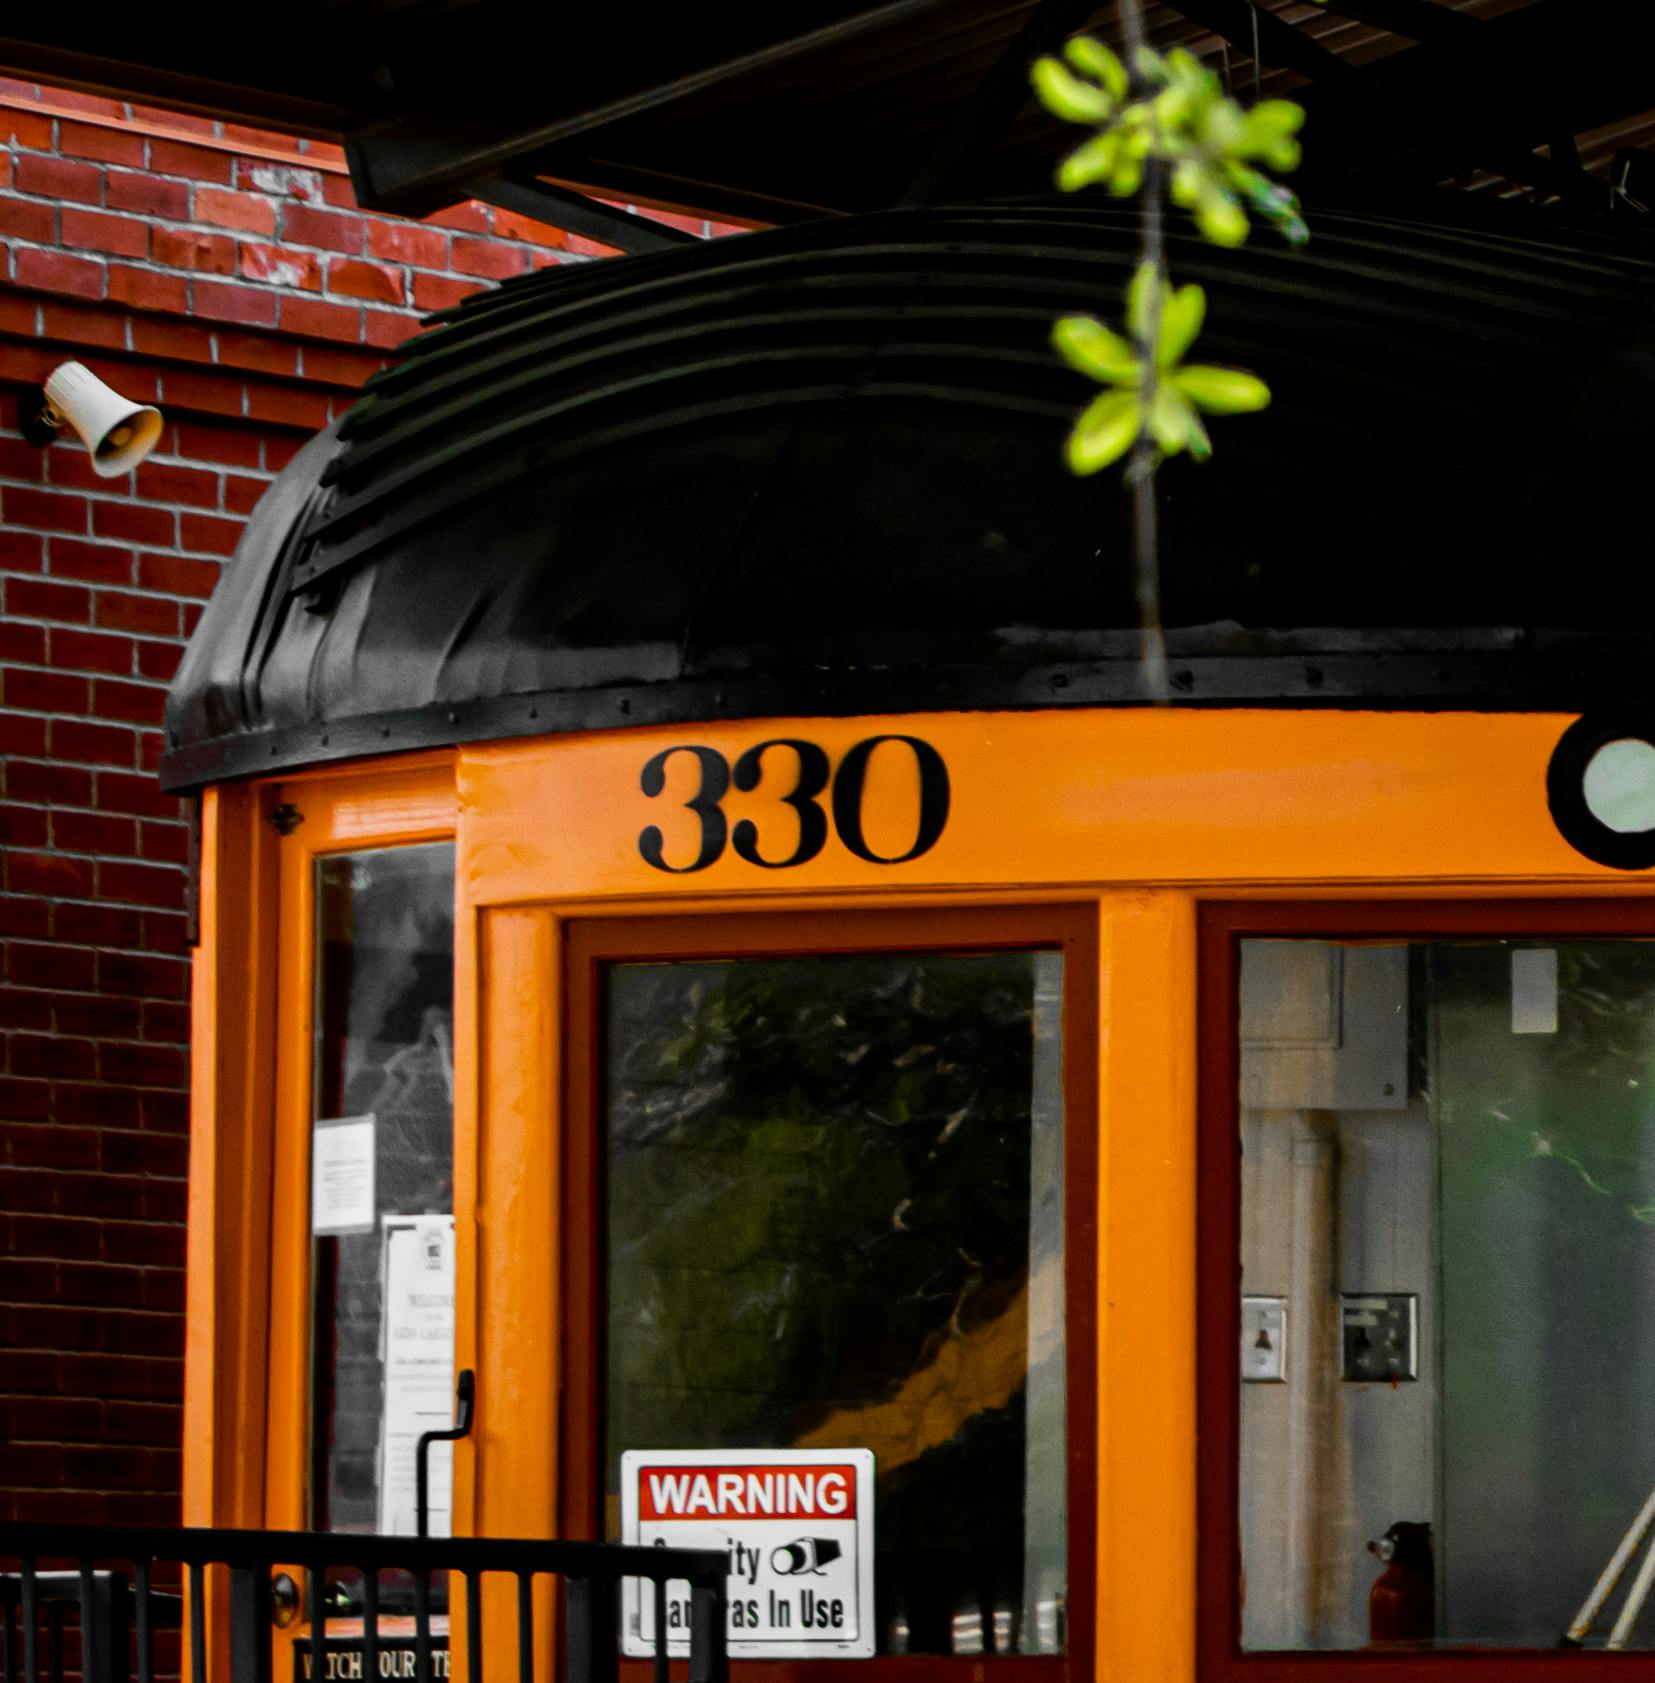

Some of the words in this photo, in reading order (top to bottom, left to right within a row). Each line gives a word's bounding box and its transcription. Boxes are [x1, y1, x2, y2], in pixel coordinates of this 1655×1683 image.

[637, 734, 950, 874] 330
[650, 1473, 848, 1515] WARNING
[769, 1589, 791, 1628] In
[800, 1588, 844, 1628] Use
[379, 1650, 416, 1678] OUR
